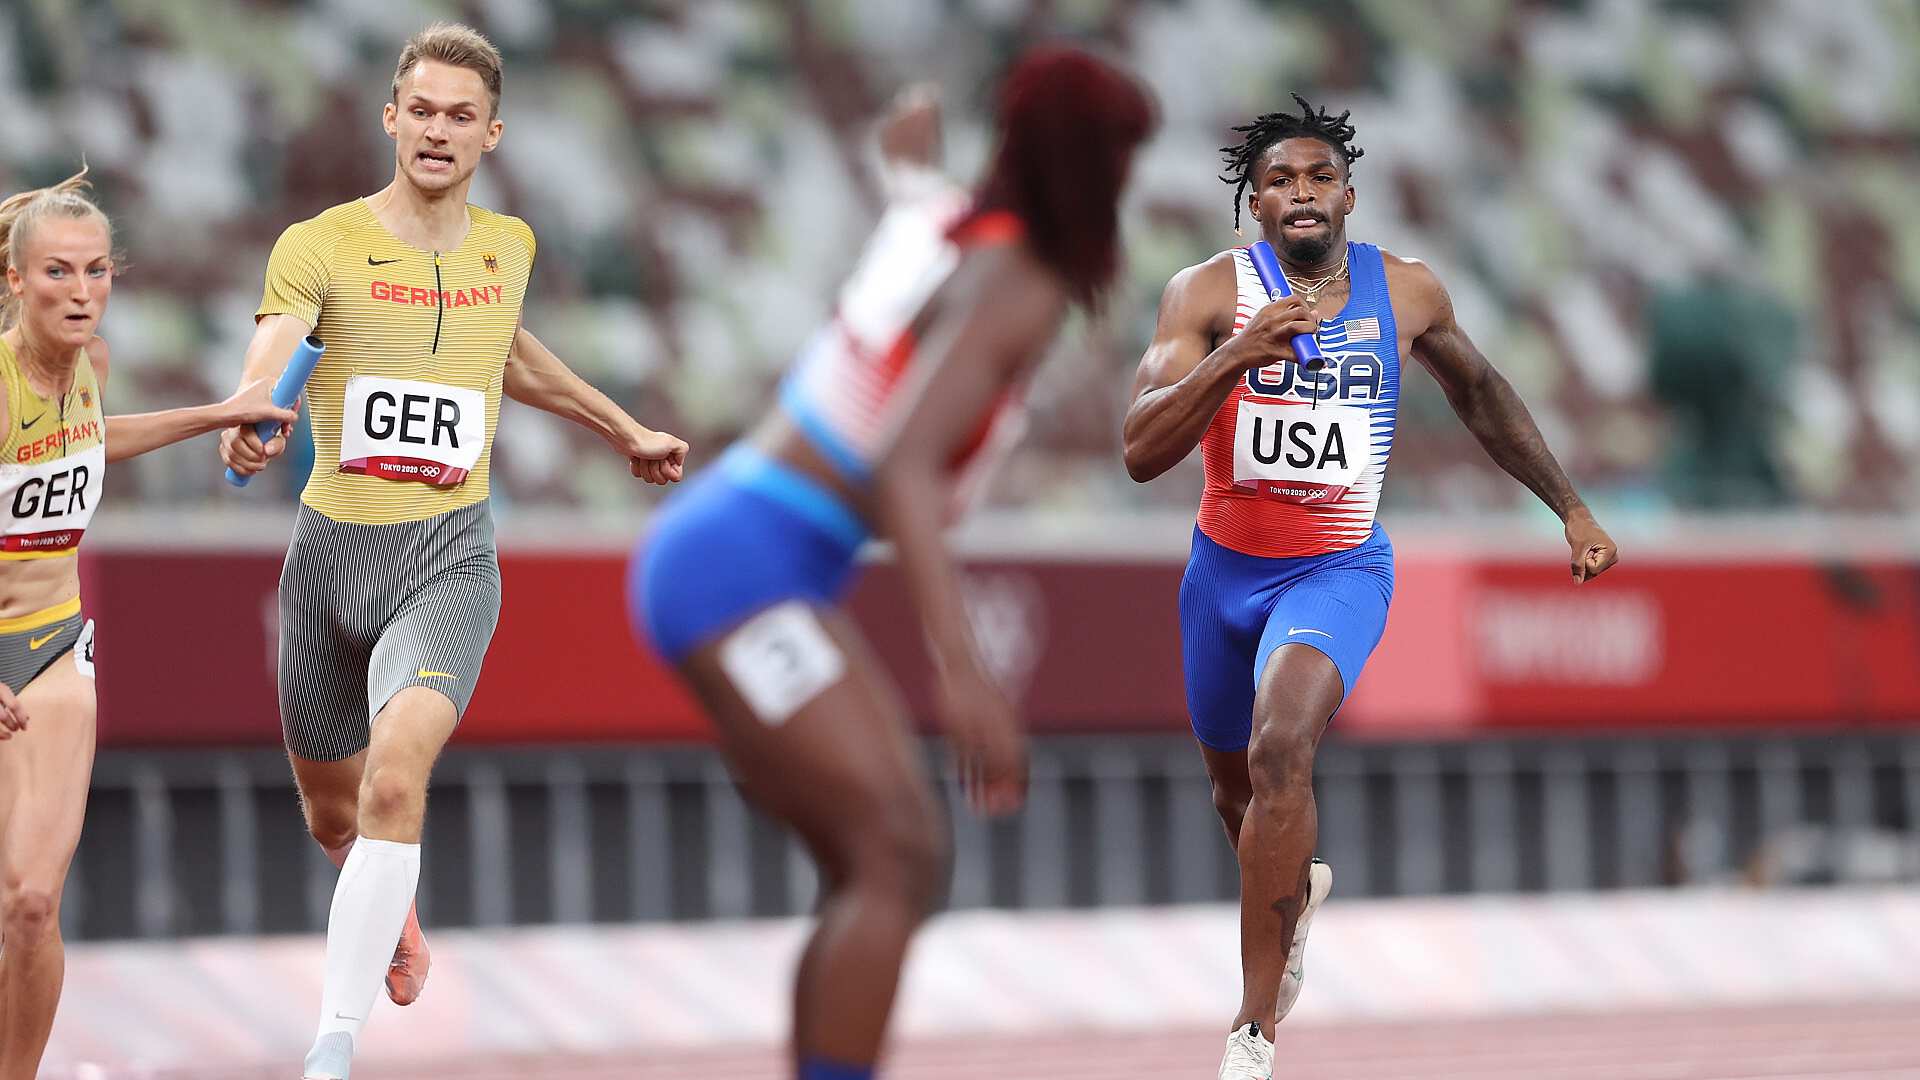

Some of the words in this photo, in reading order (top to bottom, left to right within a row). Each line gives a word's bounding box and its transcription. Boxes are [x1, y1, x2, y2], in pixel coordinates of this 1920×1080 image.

[371, 281, 502, 309] GERMANY
[1247, 352, 1383, 400] USA
[17, 420, 100, 463] GERMANY
[364, 391, 461, 448] GER
[1252, 417, 1349, 469] USA
[380, 463, 401, 472] TOKYO
[401, 465, 418, 474] 2020
[12, 465, 89, 519] GER
[1270, 486, 1290, 495] TOKYO
[1290, 489, 1307, 497] 2020
